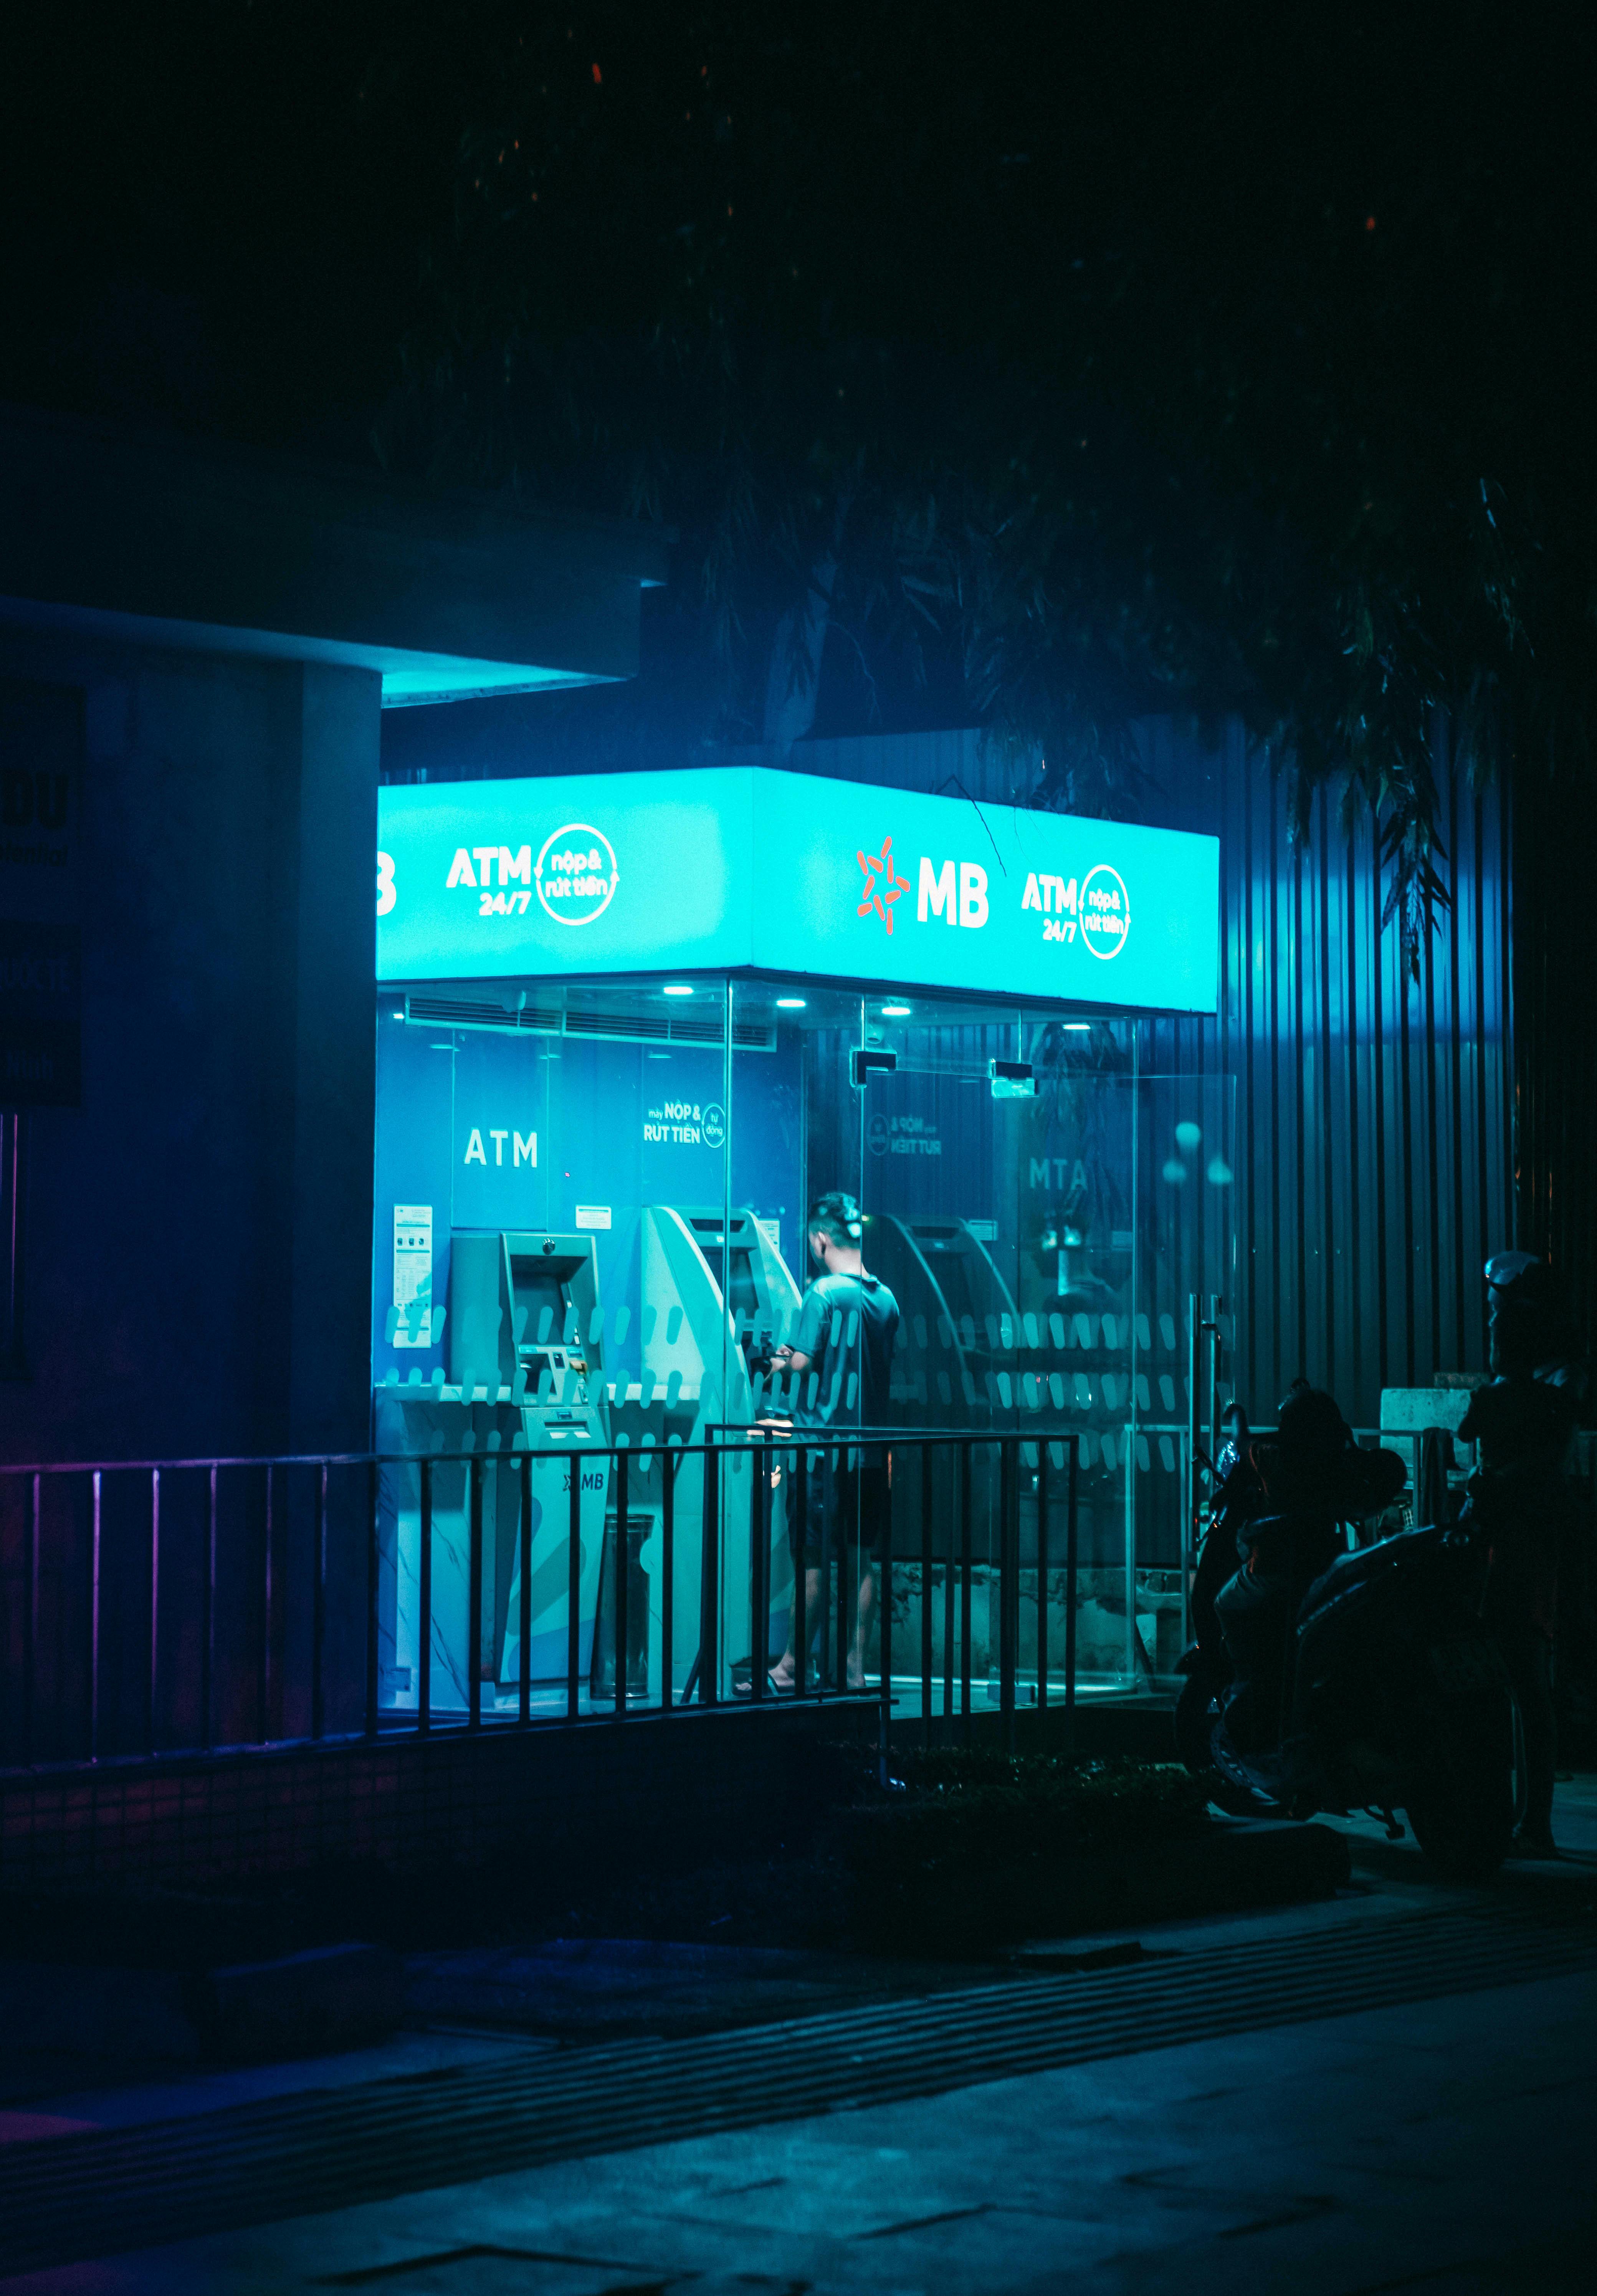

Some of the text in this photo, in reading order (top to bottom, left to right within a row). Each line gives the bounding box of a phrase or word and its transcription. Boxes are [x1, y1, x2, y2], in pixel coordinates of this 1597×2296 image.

[446, 845, 531, 888] ATM
[479, 891, 532, 916] 24/7
[917, 856, 989, 928] MB
[1021, 872, 1077, 915] ATM
[1042, 918, 1077, 943] 24/7
[664, 1098, 692, 1124] NỘP
[692, 1103, 701, 1121] &
[643, 1121, 670, 1142] RÚT
[463, 1127, 537, 1168] ATM
[581, 1473, 604, 1491] MB
